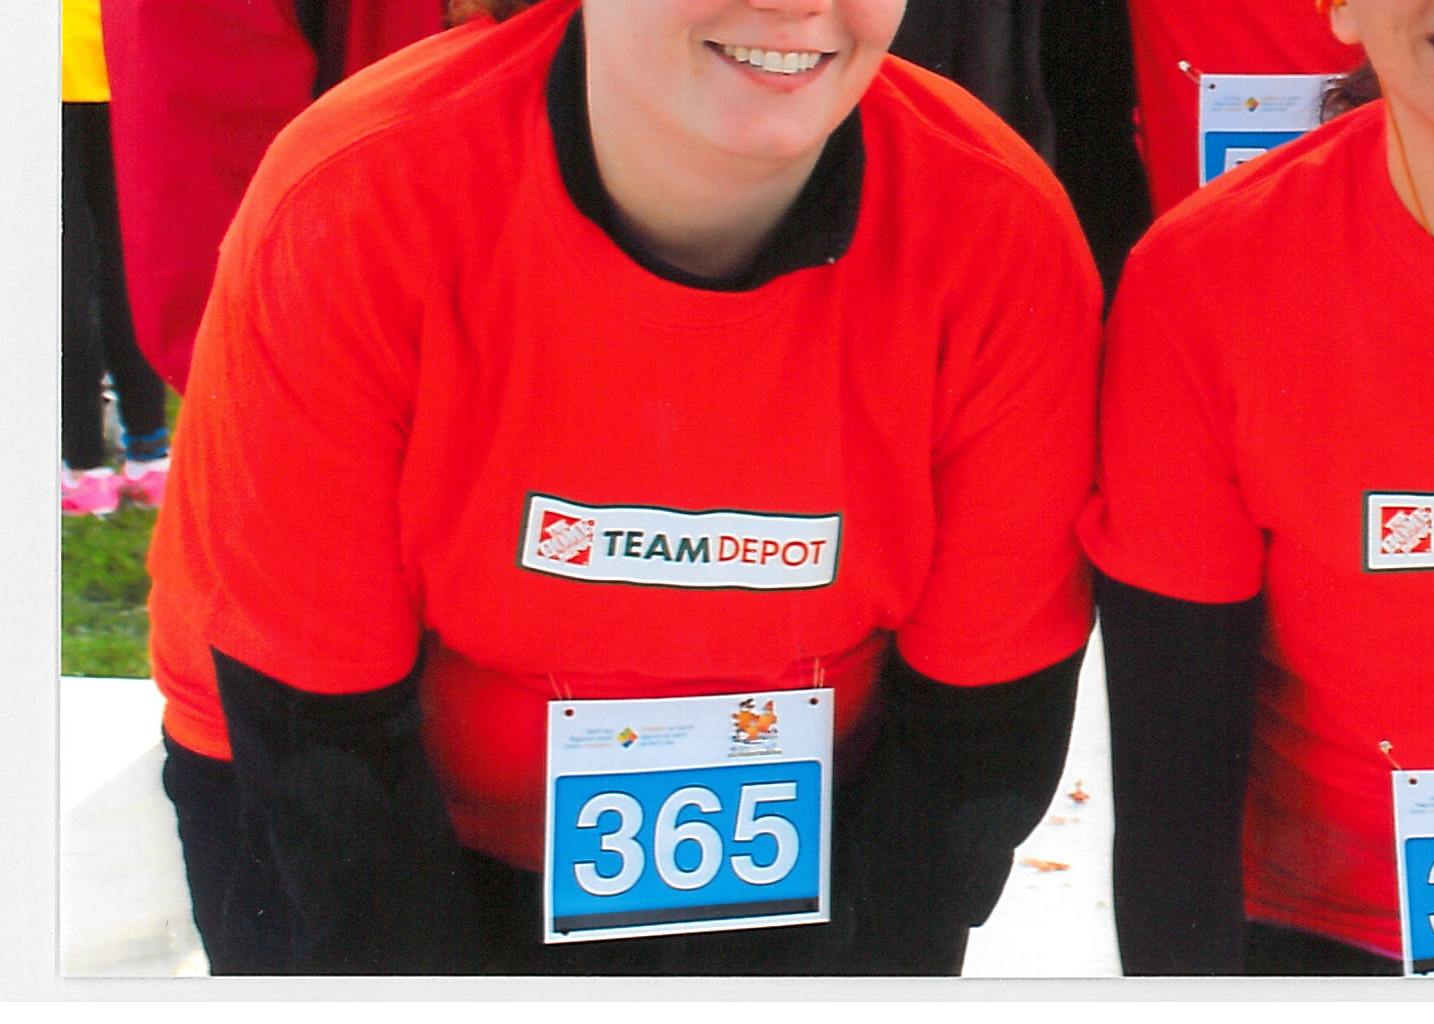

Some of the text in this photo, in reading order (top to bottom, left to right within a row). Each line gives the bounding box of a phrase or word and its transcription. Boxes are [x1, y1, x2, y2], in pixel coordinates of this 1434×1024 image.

[603, 530, 826, 567] TEAM DEPOT
[574, 782, 800, 897] 365
